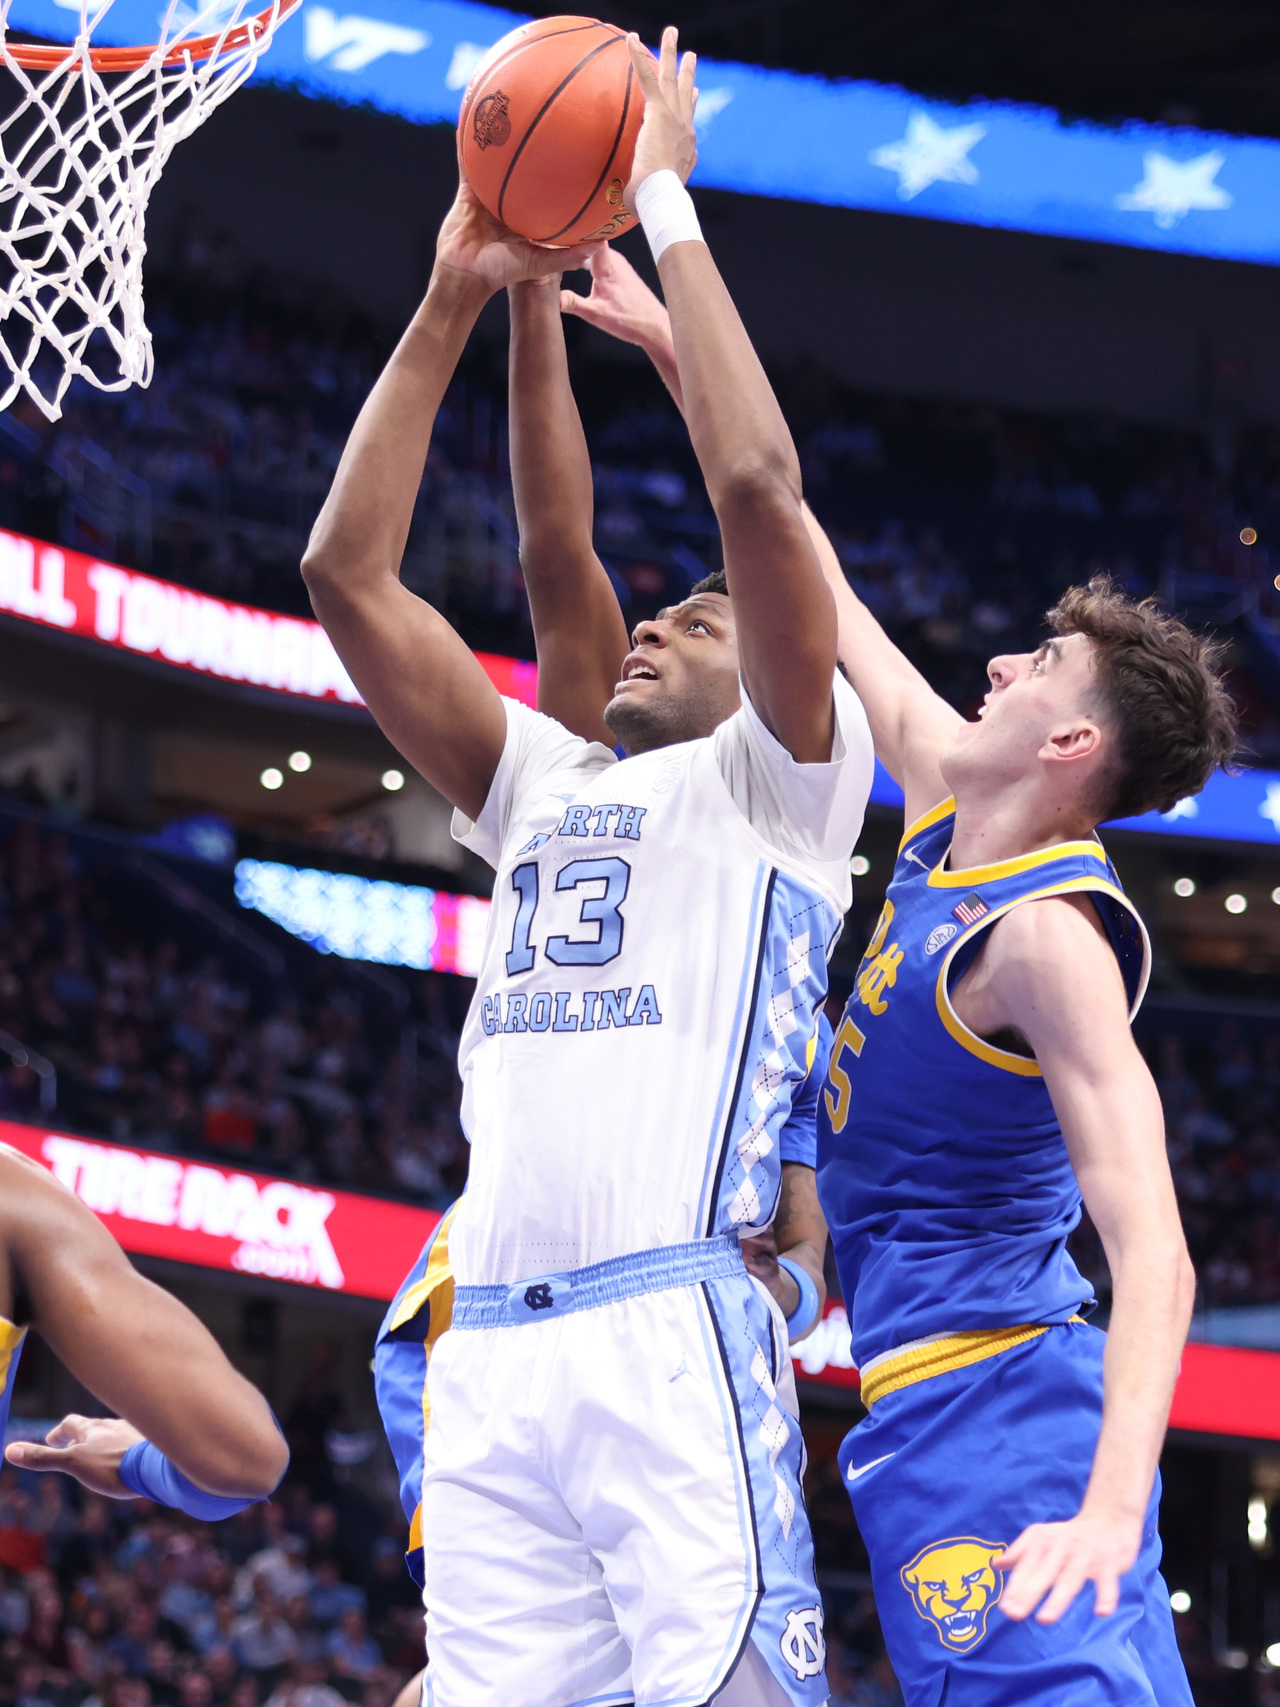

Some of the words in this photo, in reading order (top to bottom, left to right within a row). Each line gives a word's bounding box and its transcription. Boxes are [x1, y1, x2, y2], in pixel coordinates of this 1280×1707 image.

[87, 562, 368, 706] TOURNAM
[506, 857, 631, 977] 13
[481, 984, 662, 1035] CAROLINA
[42, 1135, 183, 1226] TIRE
[175, 1165, 345, 1289] RACK
